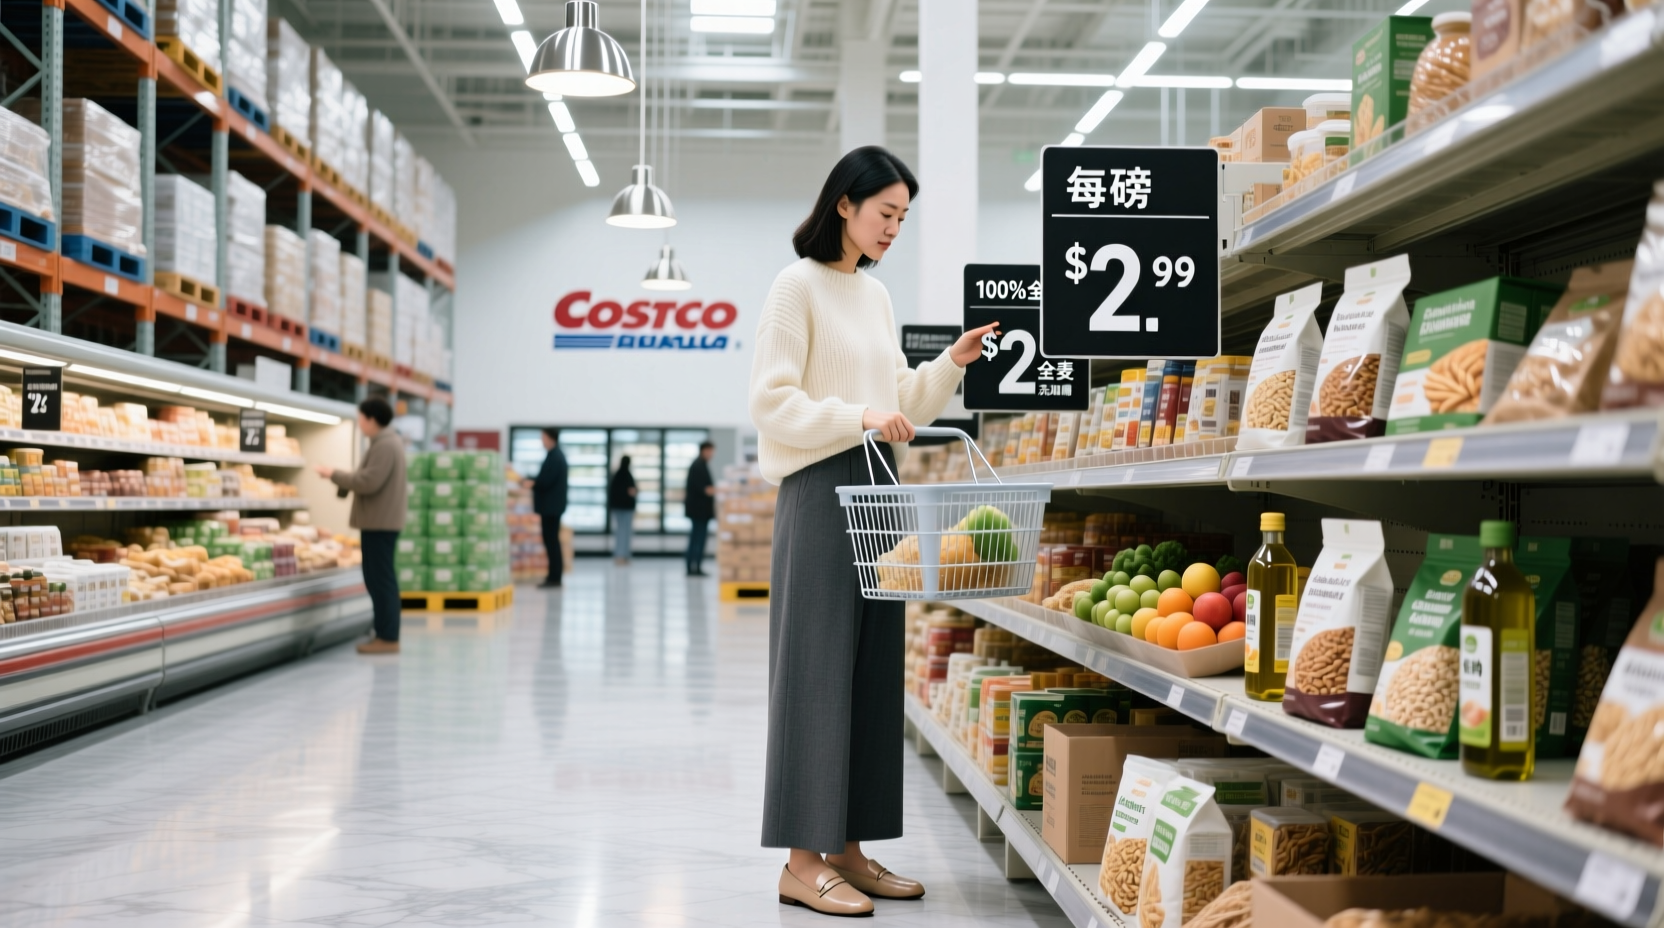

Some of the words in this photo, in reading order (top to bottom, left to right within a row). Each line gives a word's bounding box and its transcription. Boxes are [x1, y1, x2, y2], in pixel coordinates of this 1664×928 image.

[1066, 165, 1152, 209] 每磅
[1064, 241, 1196, 333] $2.99
[554, 290, 738, 330] COSTCO
[1036, 360, 1075, 381] 全麦
